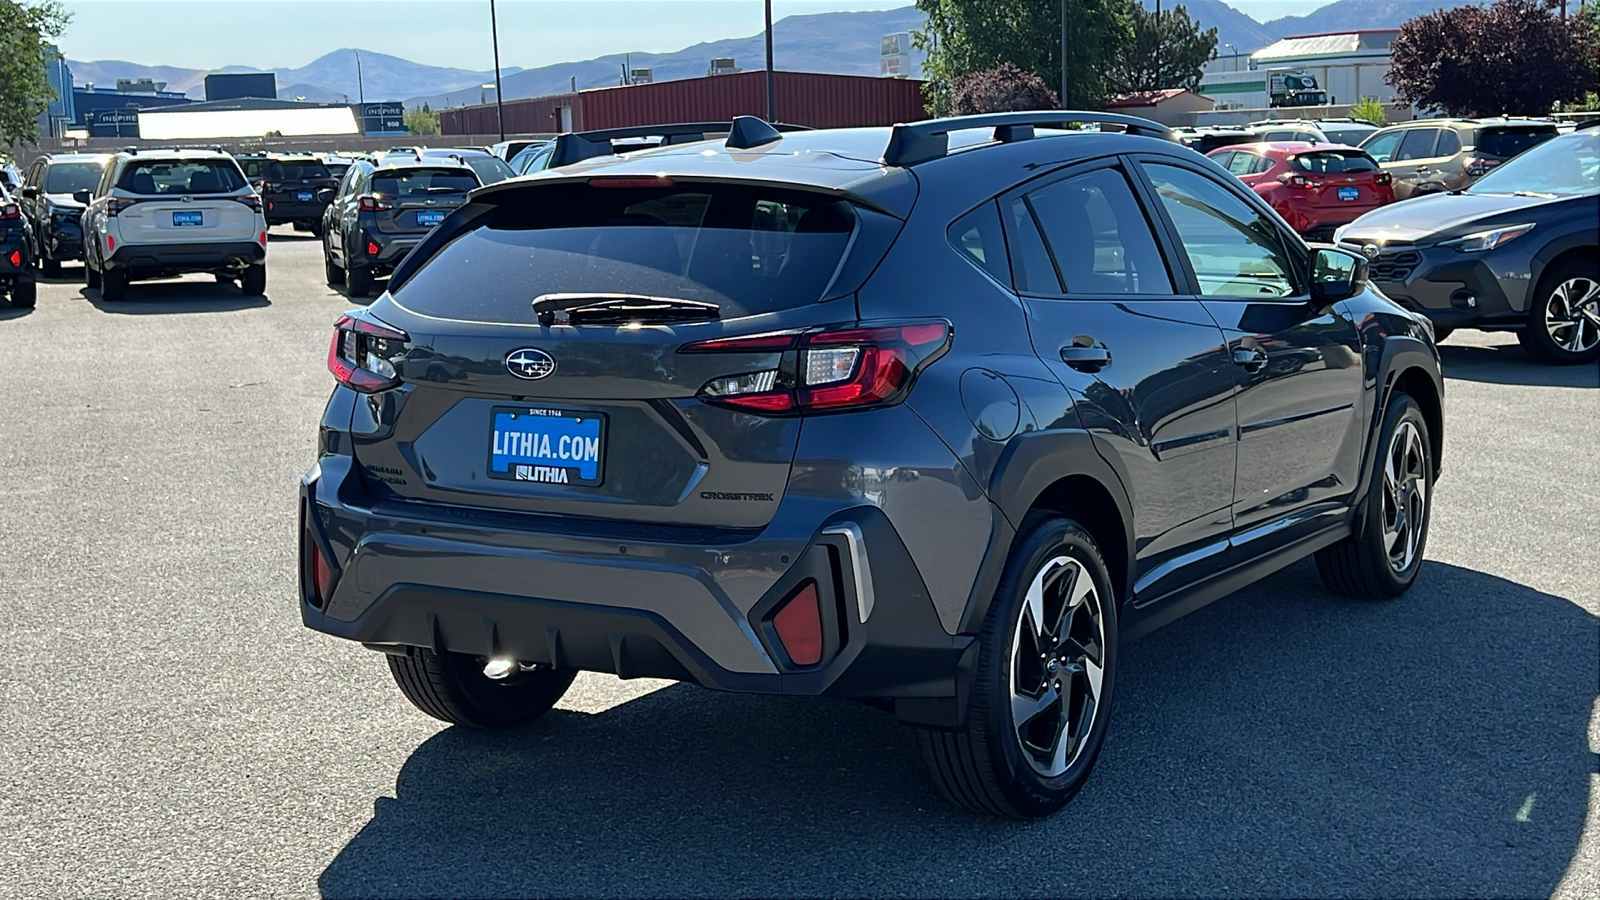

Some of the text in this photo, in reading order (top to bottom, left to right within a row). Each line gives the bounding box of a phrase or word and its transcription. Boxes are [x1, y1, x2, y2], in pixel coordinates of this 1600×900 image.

[529, 408, 547, 416] SINCE
[493, 430, 599, 462] LITHIA.COM
[527, 465, 569, 484] LITHIA
[700, 491, 774, 502] CROSSTREK
